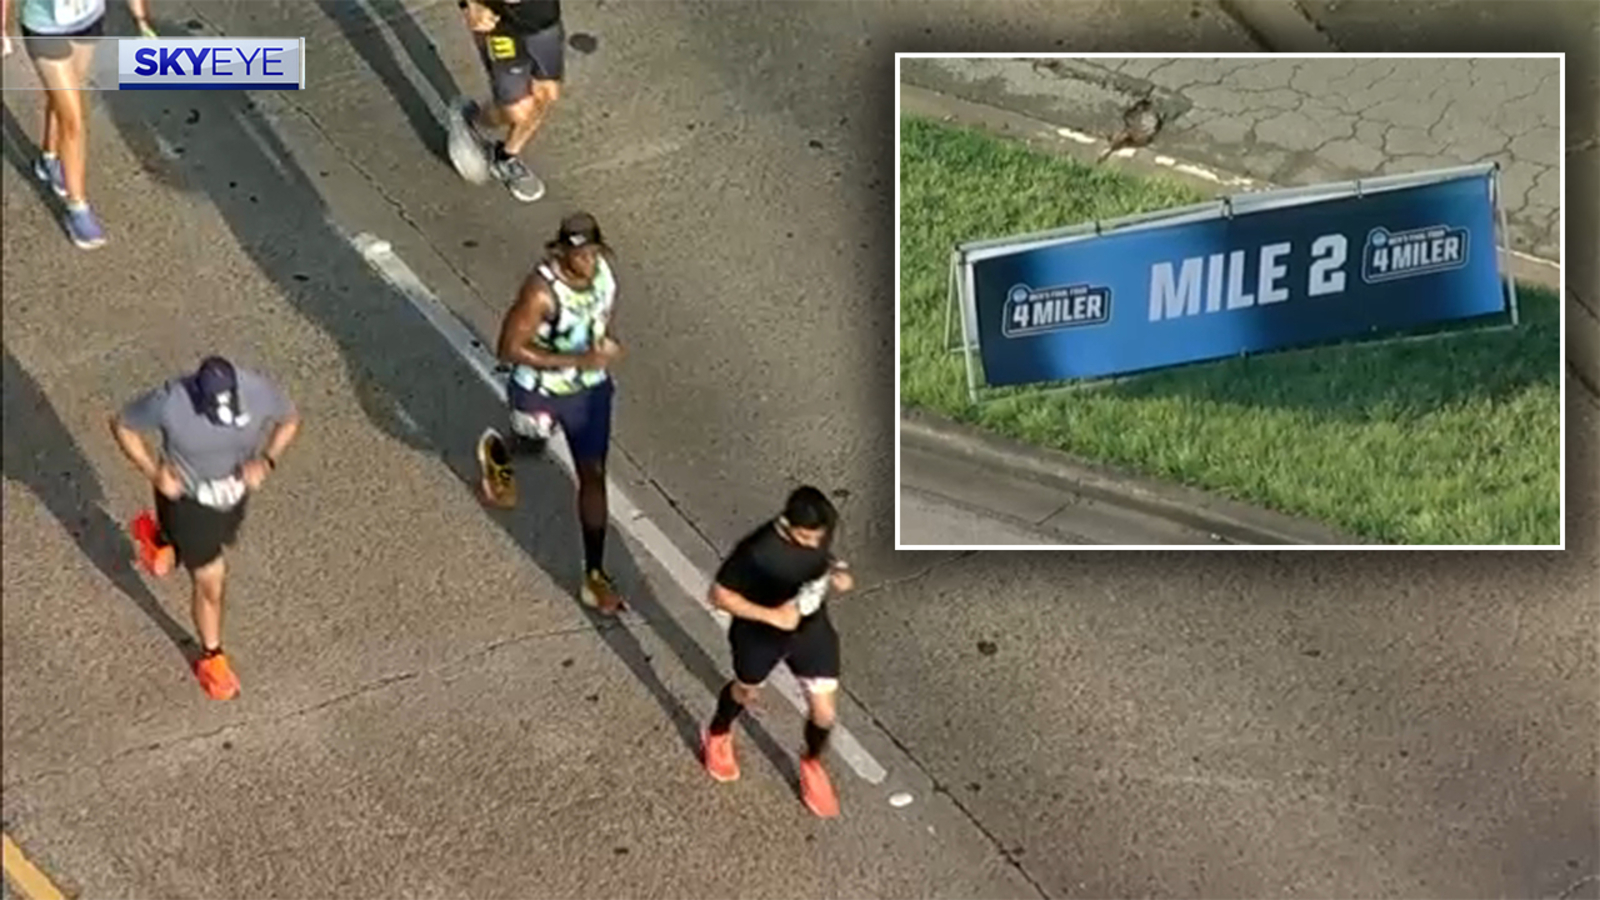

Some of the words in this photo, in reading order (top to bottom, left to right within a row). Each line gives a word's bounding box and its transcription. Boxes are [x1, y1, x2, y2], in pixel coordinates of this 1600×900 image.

[1373, 248, 1388, 272] 4
[1392, 236, 1459, 270] MILER
[1149, 241, 1291, 322] MILE
[1308, 233, 1348, 296] 2
[1013, 303, 1029, 327] 4
[1032, 294, 1102, 326] MILER
